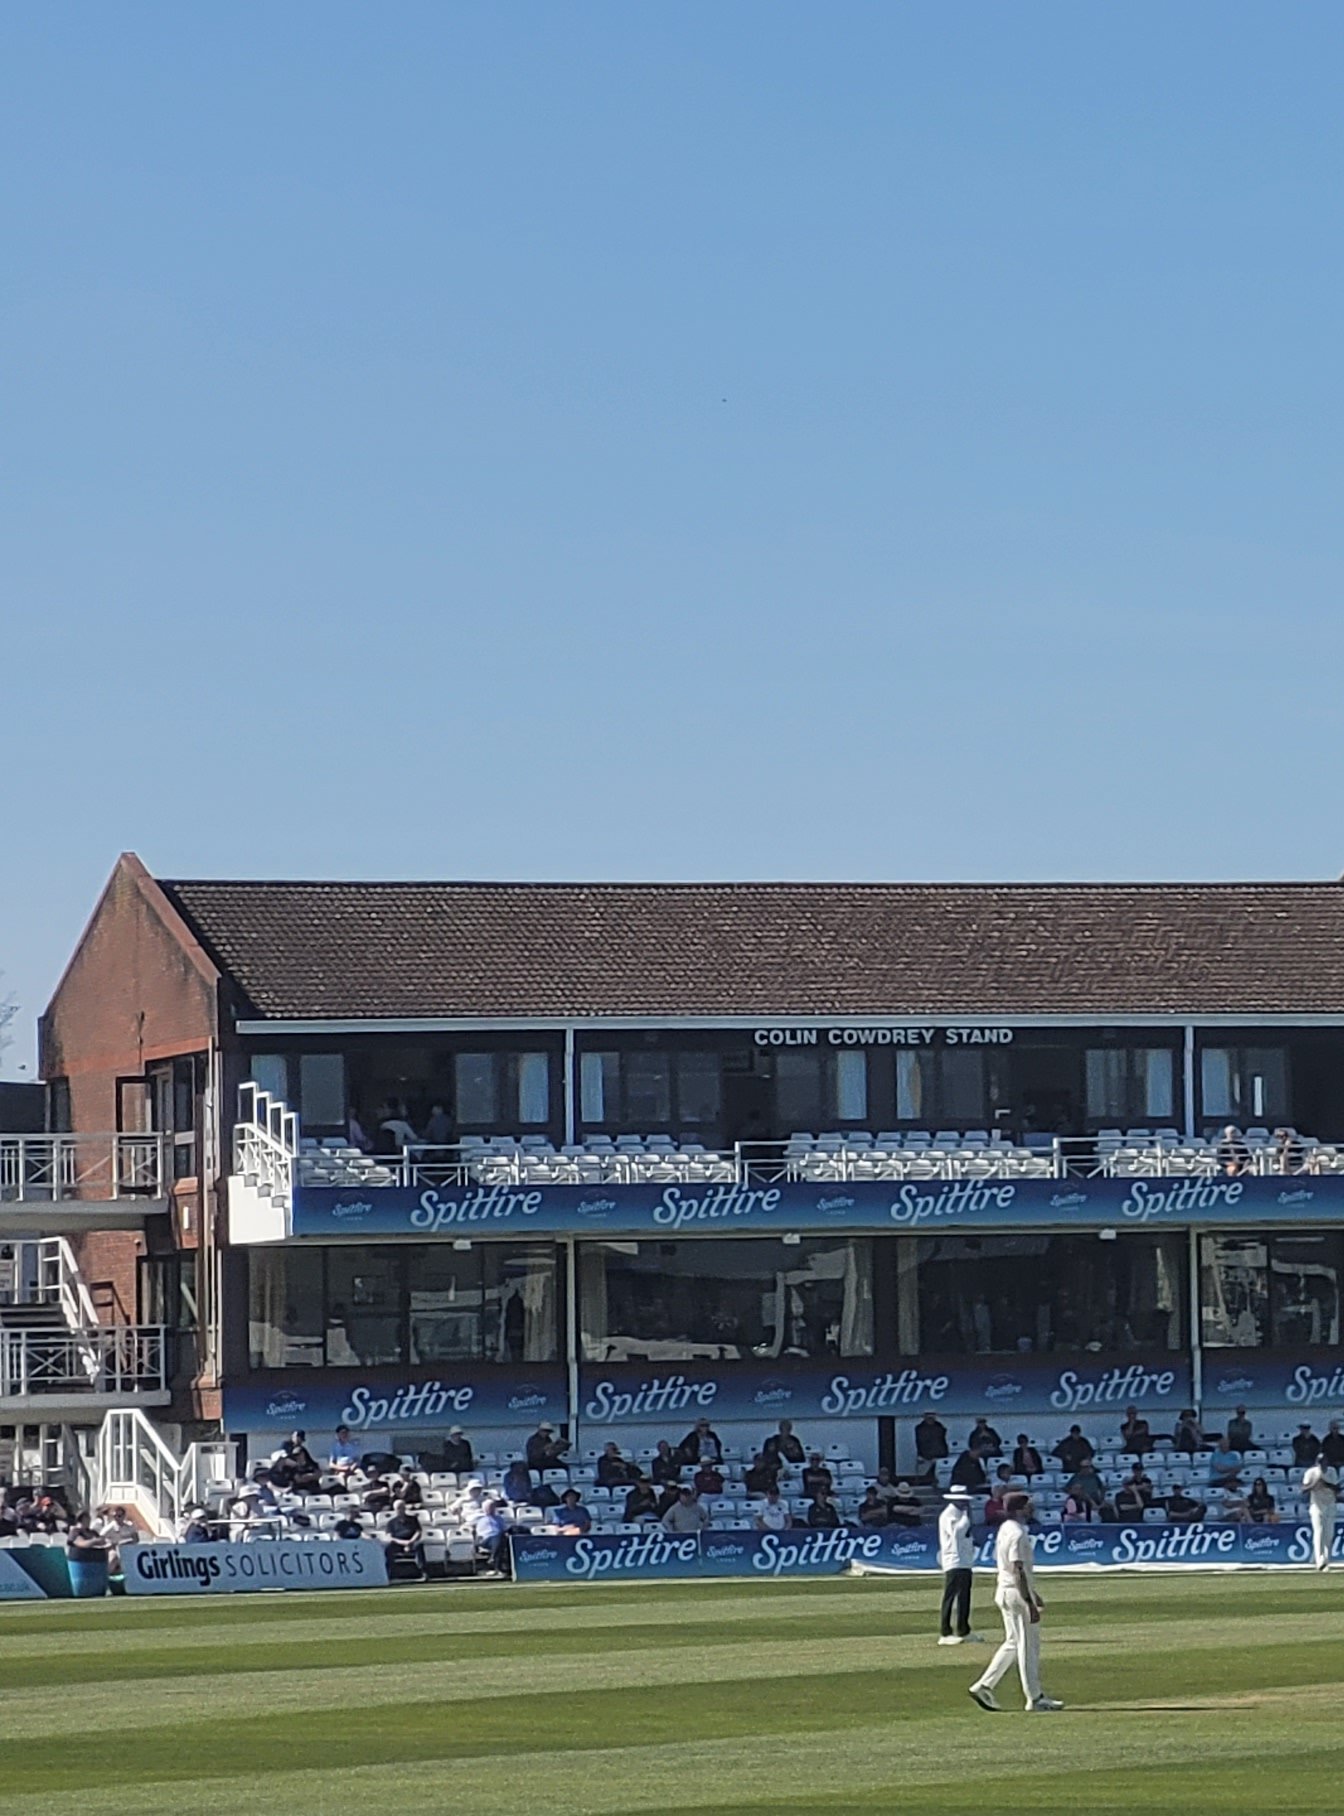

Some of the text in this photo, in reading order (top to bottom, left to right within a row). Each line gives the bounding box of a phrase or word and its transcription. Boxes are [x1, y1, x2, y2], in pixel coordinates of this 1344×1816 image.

[754, 1028, 1013, 1045] COLIN COWDREY STAND
[410, 1184, 542, 1232] Spitfire
[653, 1180, 781, 1229] Spitfire
[890, 1179, 1016, 1225] Spitfire
[1122, 1176, 1243, 1221] Spitfire
[341, 1381, 473, 1430] Spitfire
[586, 1375, 717, 1422] Spitfire
[821, 1370, 949, 1416] Spitfire
[1051, 1365, 1174, 1411] Spitfire
[565, 1532, 697, 1579] Spitfire
[752, 1528, 881, 1576] Spitfire
[1111, 1523, 1235, 1561] Spitfire
[136, 1549, 364, 1586] Girlings SOLICITORS
